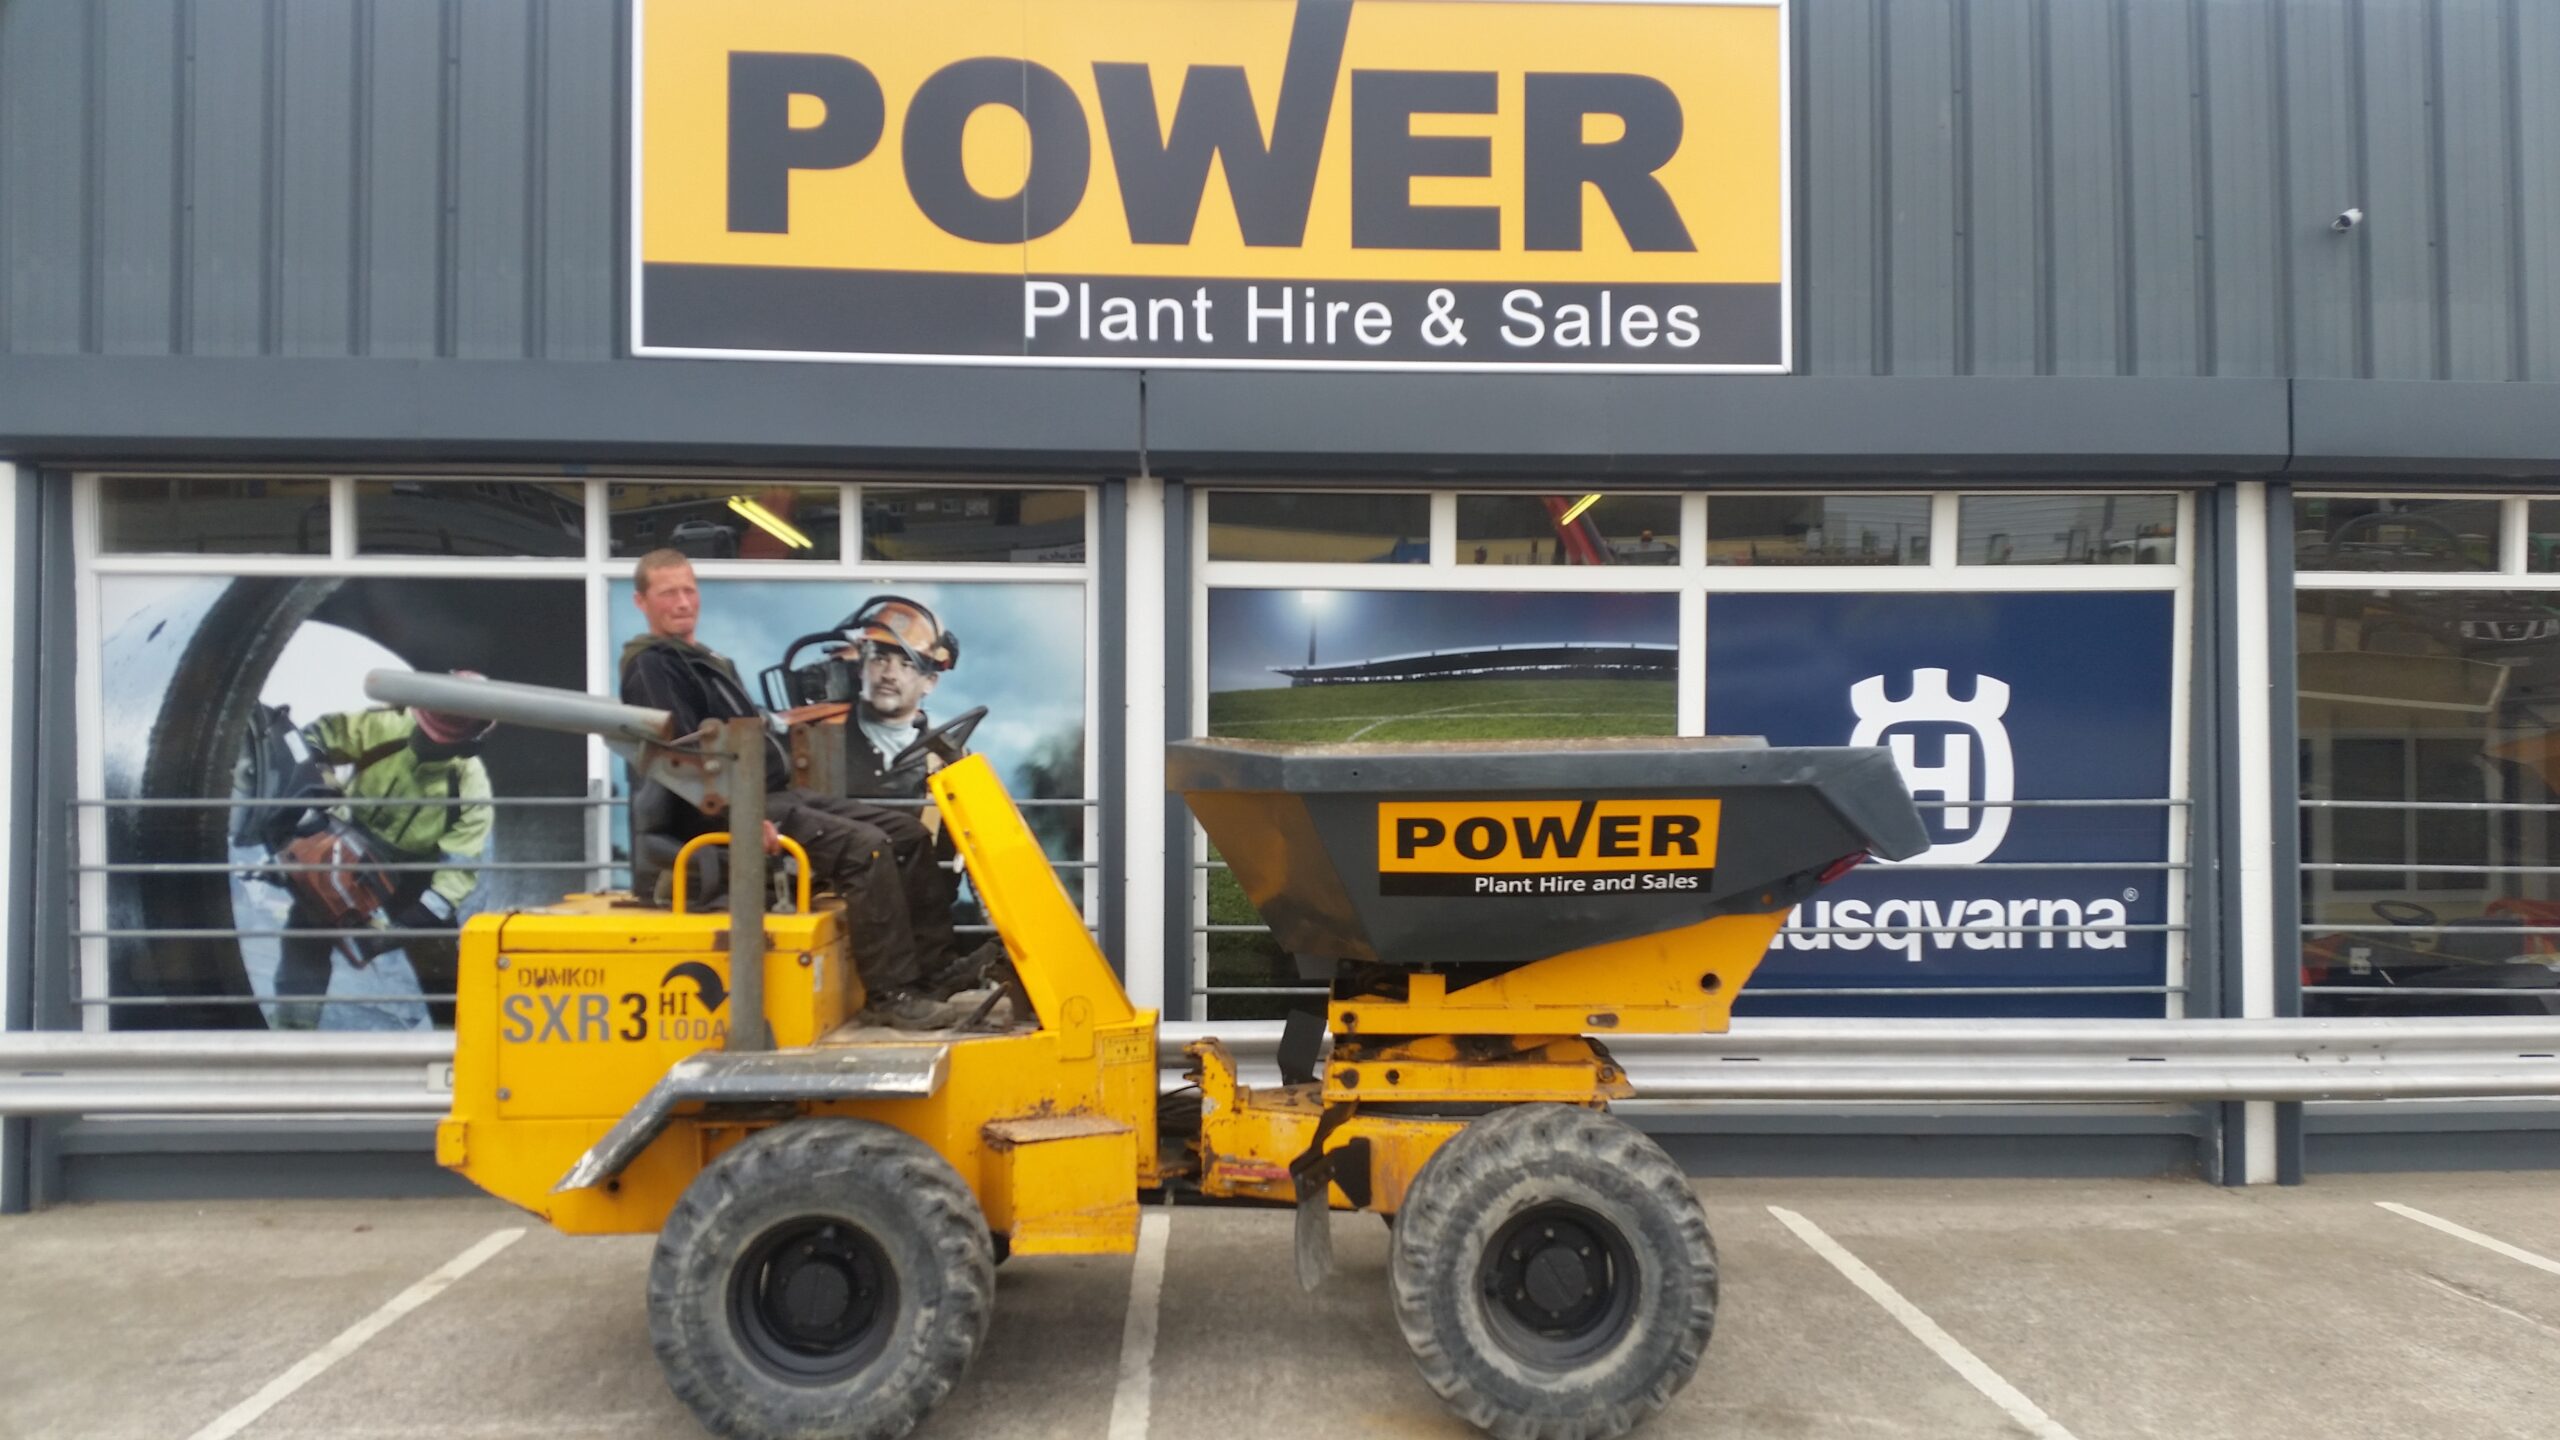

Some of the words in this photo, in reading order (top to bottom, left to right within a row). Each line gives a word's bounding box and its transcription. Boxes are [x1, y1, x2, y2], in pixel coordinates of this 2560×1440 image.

[726, 0, 1698, 253] POWER
[1024, 281, 1213, 342] Plant
[1247, 286, 1392, 346] Hire
[1420, 289, 1467, 347] &
[1500, 290, 1700, 347] Sales
[1396, 801, 1701, 860] POWER
[1475, 877, 1532, 893] Plant
[1540, 876, 1586, 892] Hire
[1592, 874, 1635, 891] and
[1642, 873, 1698, 890] Sales
[503, 993, 610, 1043] SXR
[620, 992, 648, 1042] 3
[659, 992, 688, 1016] HI
